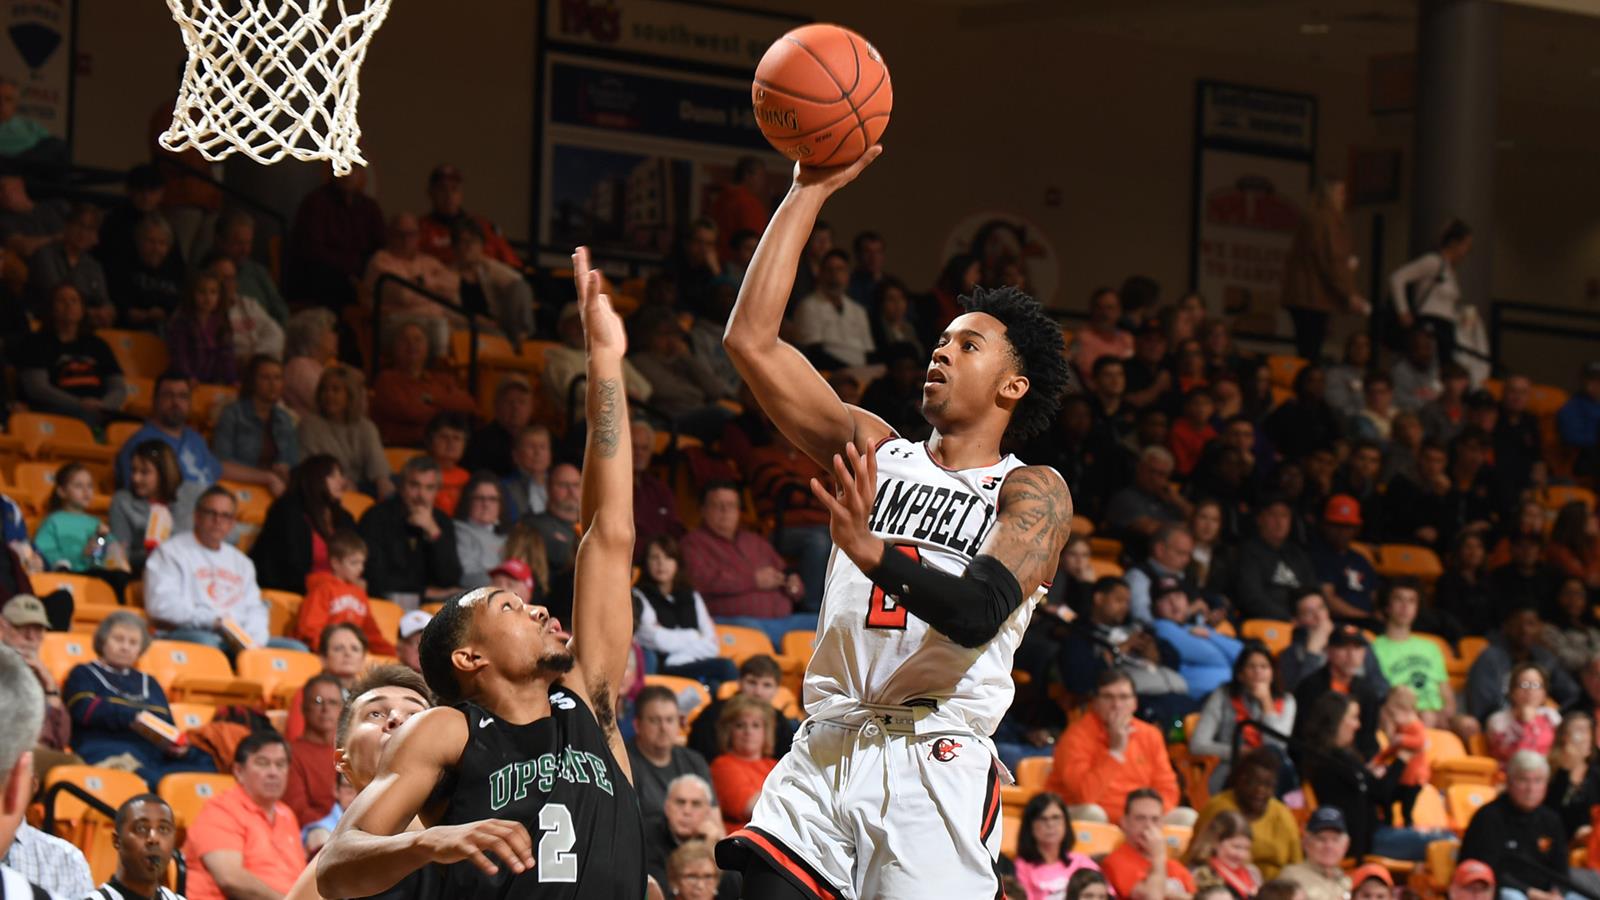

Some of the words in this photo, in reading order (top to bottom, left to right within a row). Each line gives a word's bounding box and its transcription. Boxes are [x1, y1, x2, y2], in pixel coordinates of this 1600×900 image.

[867, 478, 994, 557] AMPBELL
[489, 744, 614, 811] UPSATE
[538, 803, 578, 883] 2
